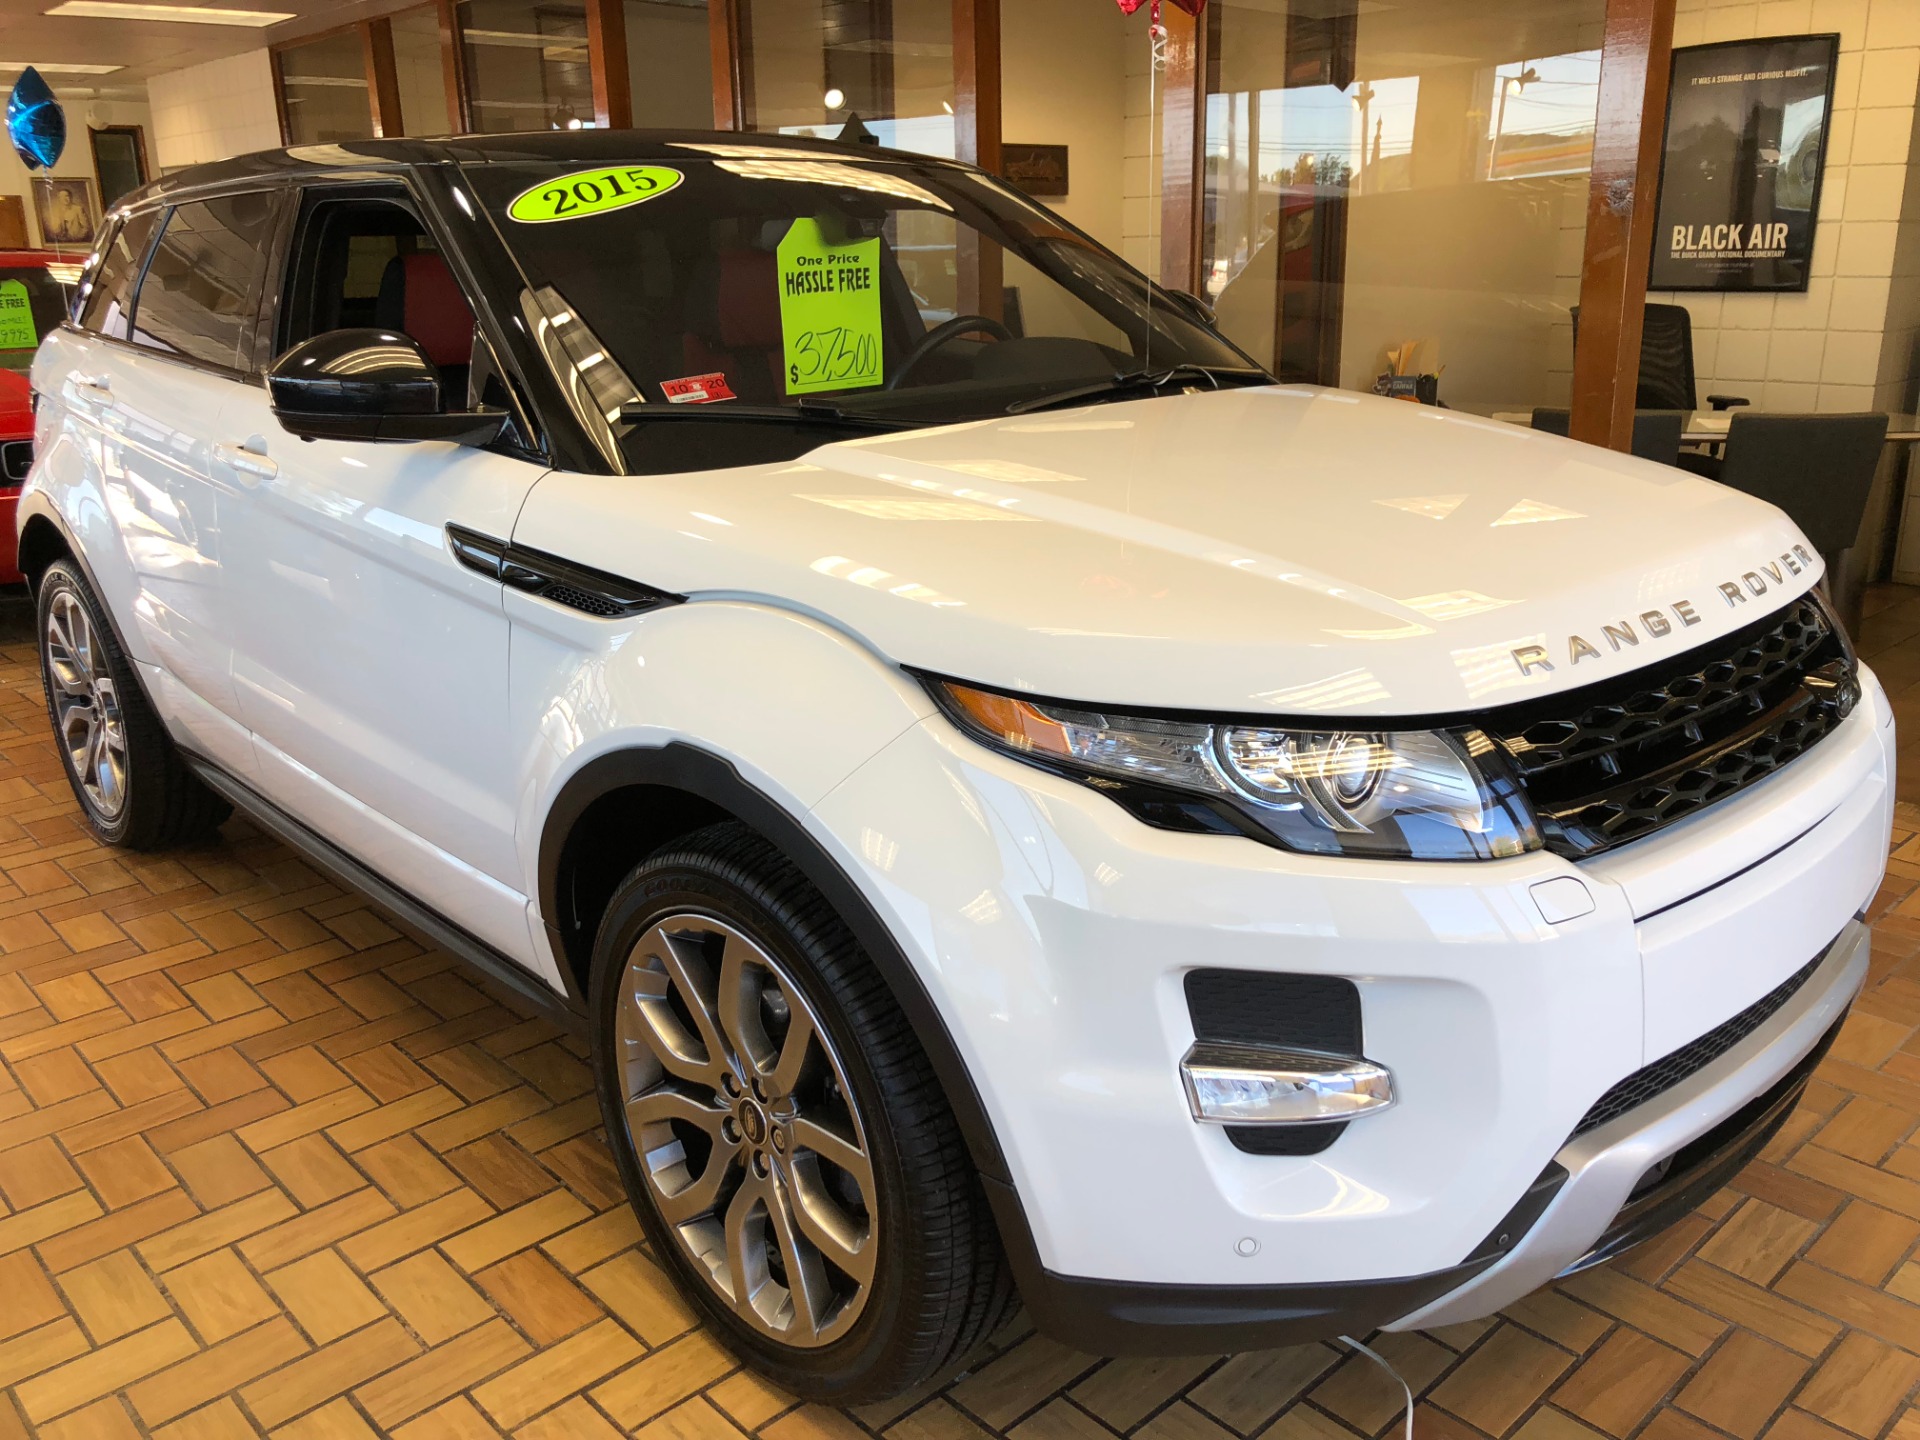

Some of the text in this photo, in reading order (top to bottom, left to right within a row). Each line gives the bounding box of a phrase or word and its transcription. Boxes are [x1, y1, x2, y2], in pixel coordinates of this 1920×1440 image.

[1698, 76, 1711, 85] WAS
[1717, 73, 1743, 84] STRANGE
[1743, 72, 1756, 81] AND
[1757, 70, 1784, 80] CURIOUS
[542, 169, 658, 215] 2015
[1671, 222, 1789, 250] BLACK AIR
[796, 254, 860, 267] One Price
[1670, 250, 1786, 259] THE BUICK GRAND NATIONAL DOCUMENTARY
[785, 267, 871, 297] HASSLE FREE
[6, 298, 25, 309] FREE
[0, 327, 30, 344] 9995
[670, 384, 689, 395] 10
[706, 378, 725, 389] 20
[1511, 543, 1814, 677] RANGE ROVER
